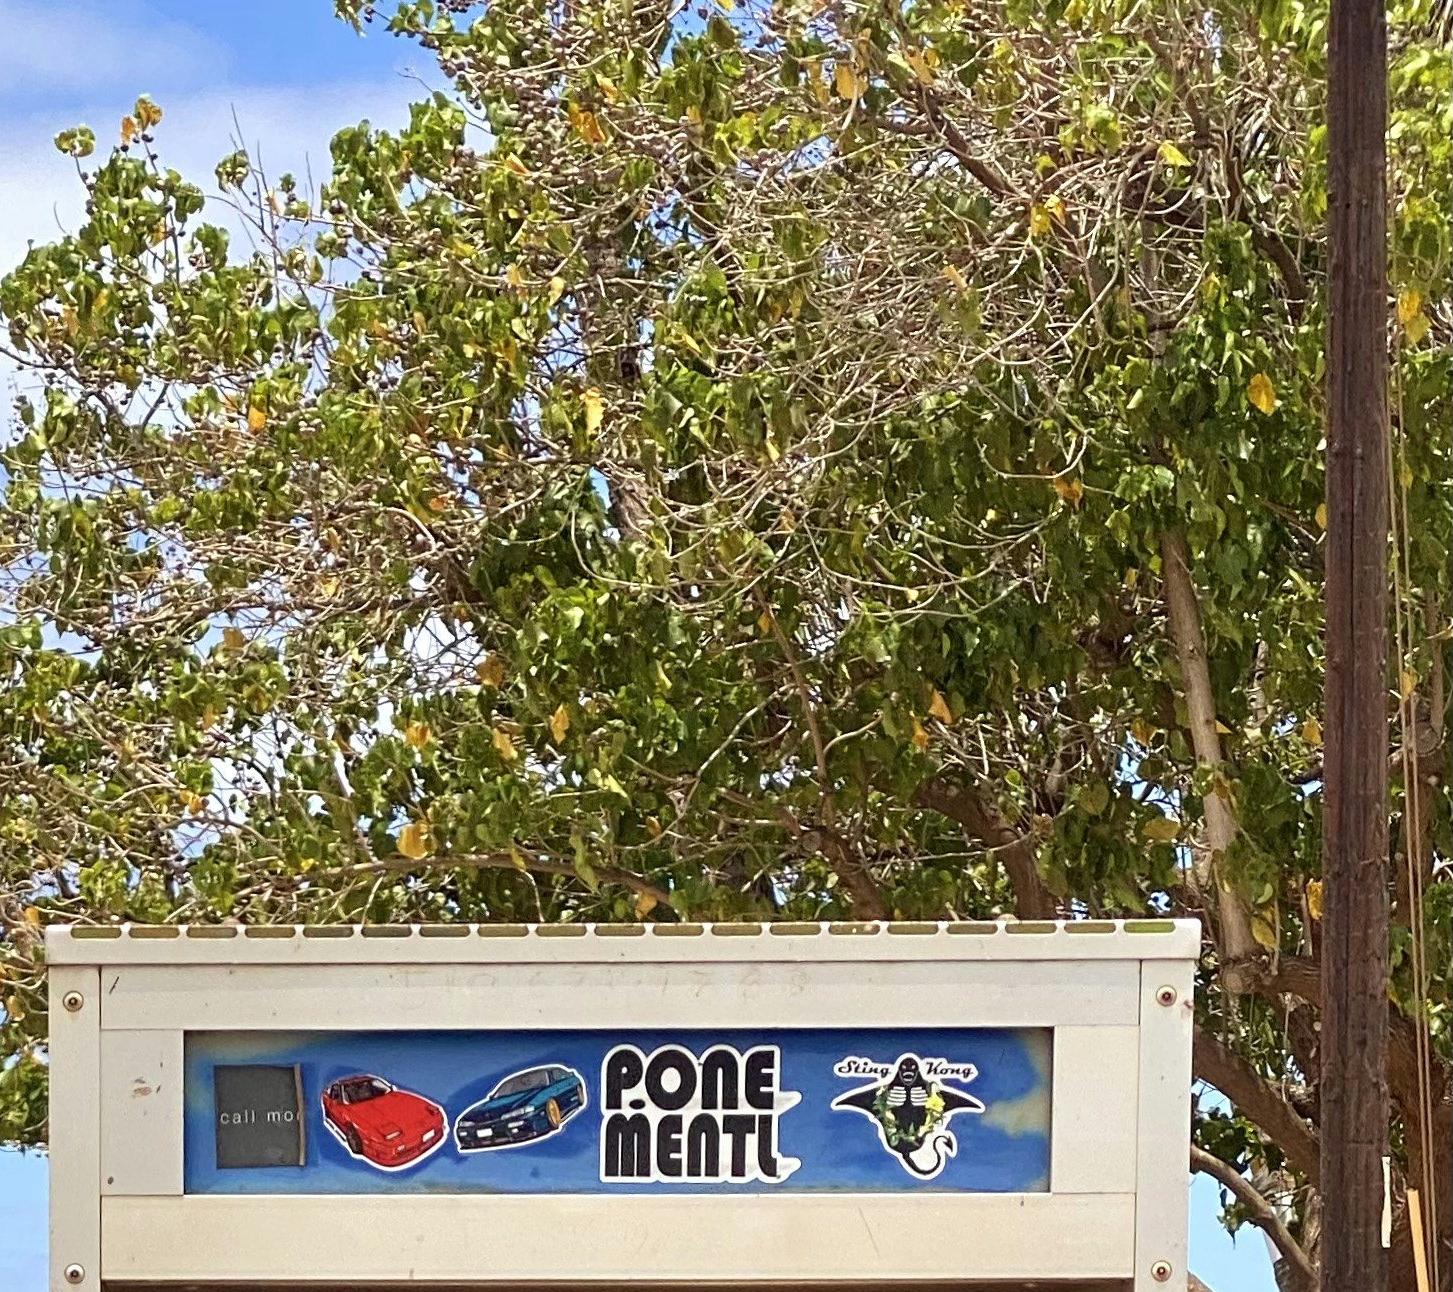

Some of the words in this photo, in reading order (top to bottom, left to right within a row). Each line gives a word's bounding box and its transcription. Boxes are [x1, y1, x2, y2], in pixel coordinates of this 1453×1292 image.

[837, 1060, 891, 1078] Sting
[925, 1061, 973, 1079] Kong
[220, 1109, 255, 1125] call
[604, 1112, 778, 1178] MENTL
